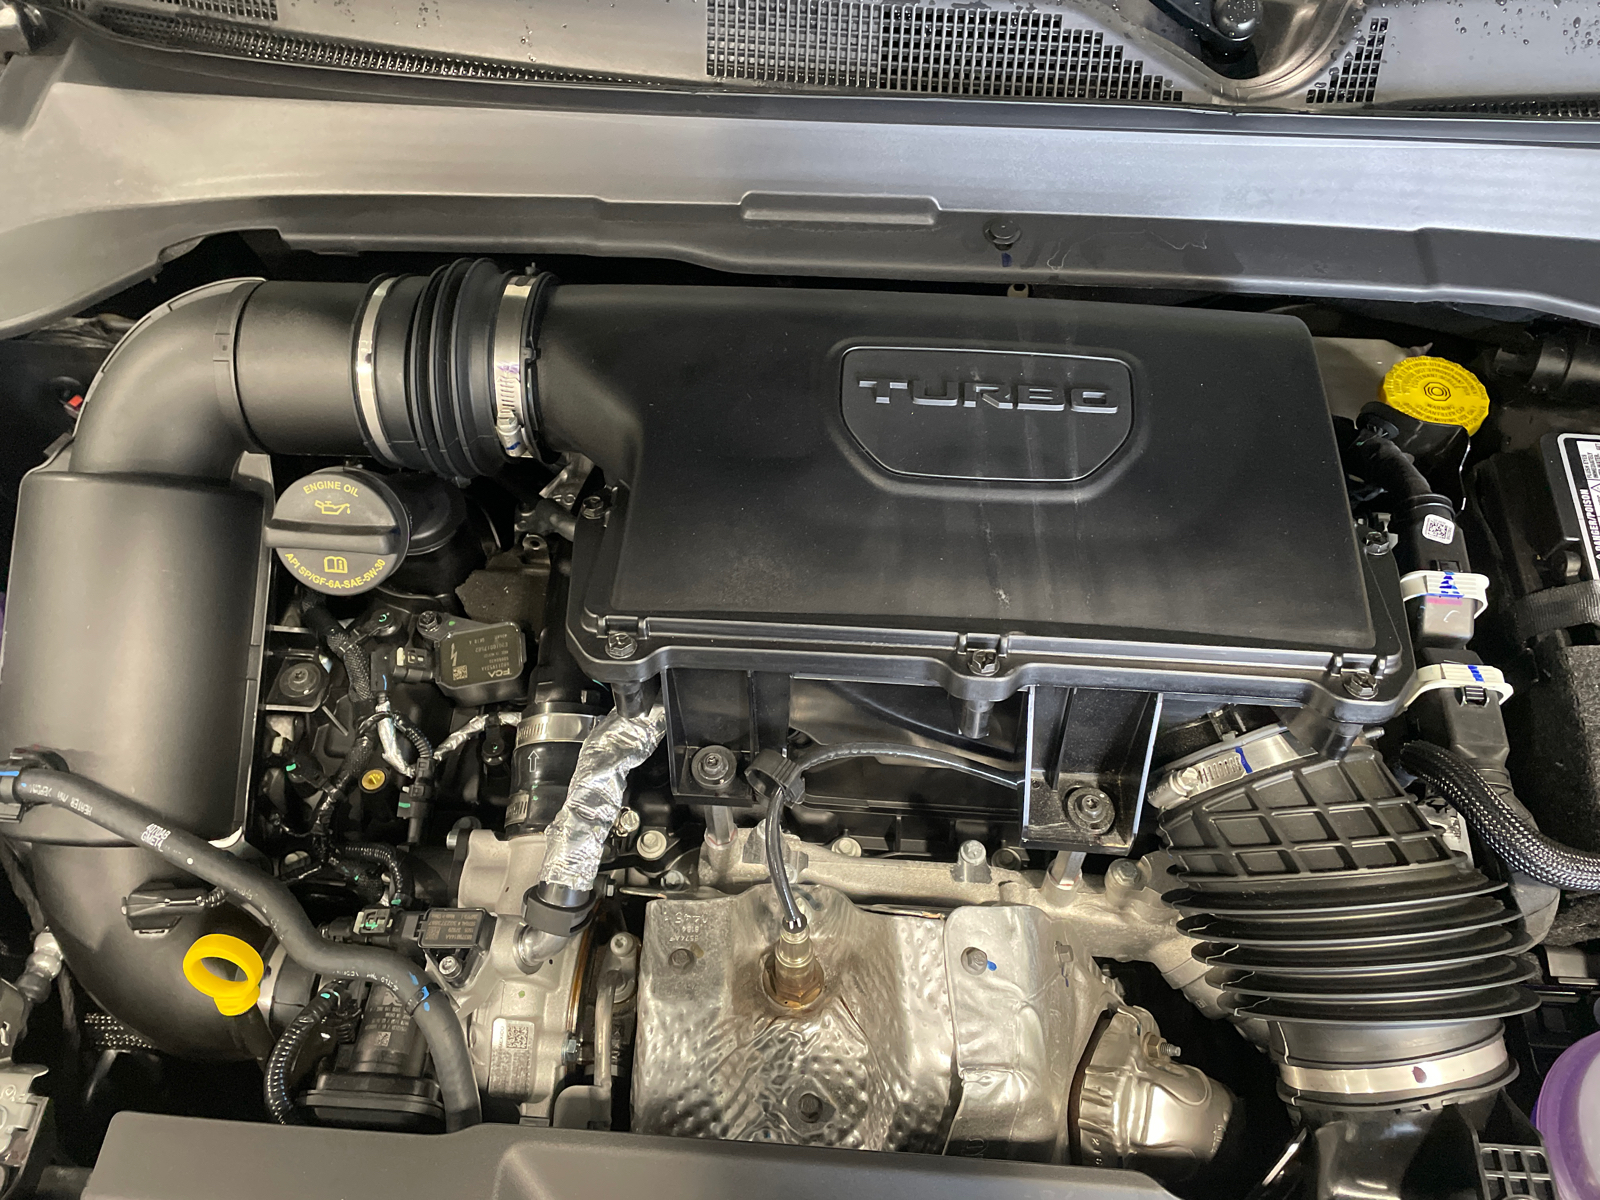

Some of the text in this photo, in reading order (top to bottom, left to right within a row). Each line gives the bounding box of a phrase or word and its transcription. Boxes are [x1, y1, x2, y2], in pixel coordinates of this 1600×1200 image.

[857, 379, 1119, 414] TURBO
[303, 481, 359, 498] ENGINE OIL
[284, 553, 386, 589] API SP/GF-6A-SAE-5W-30
[488, 667, 511, 678] FCA
